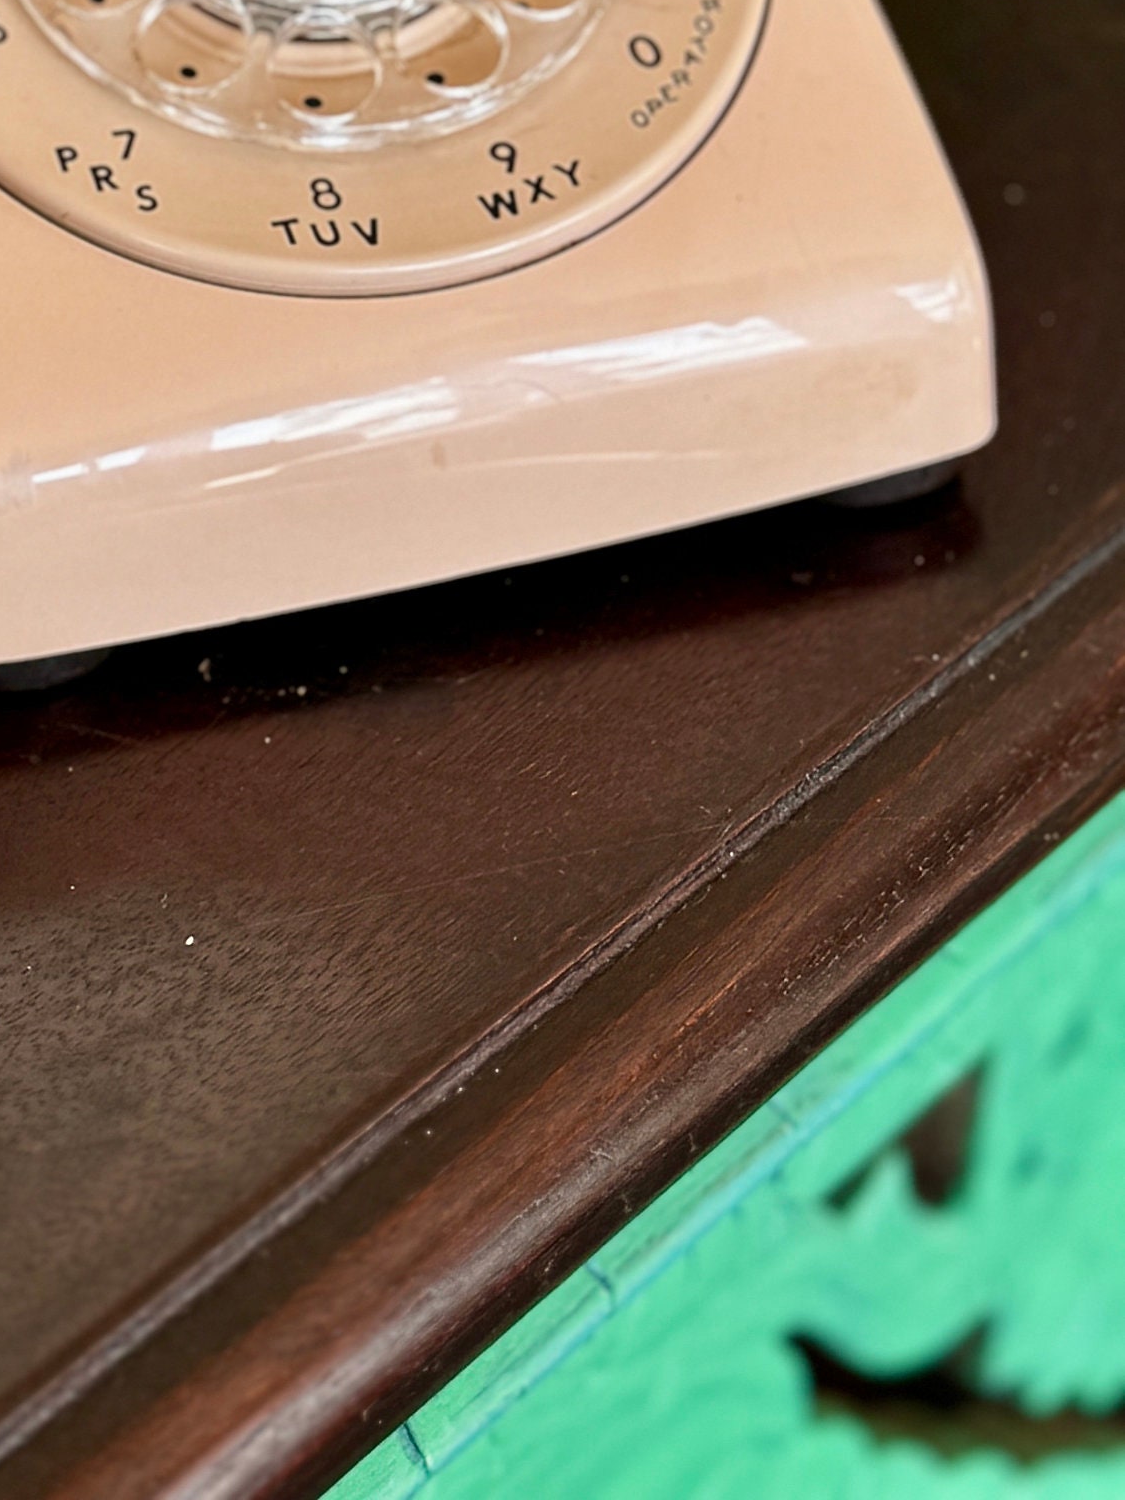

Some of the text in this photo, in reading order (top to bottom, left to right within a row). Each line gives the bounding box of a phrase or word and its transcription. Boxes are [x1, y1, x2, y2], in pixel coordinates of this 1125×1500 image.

[112, 129, 137, 160] 7
[489, 141, 517, 173] 9
[55, 146, 158, 212] PRS
[310, 178, 342, 211] 8
[478, 160, 581, 220] WXY
[271, 217, 379, 246] TUV
